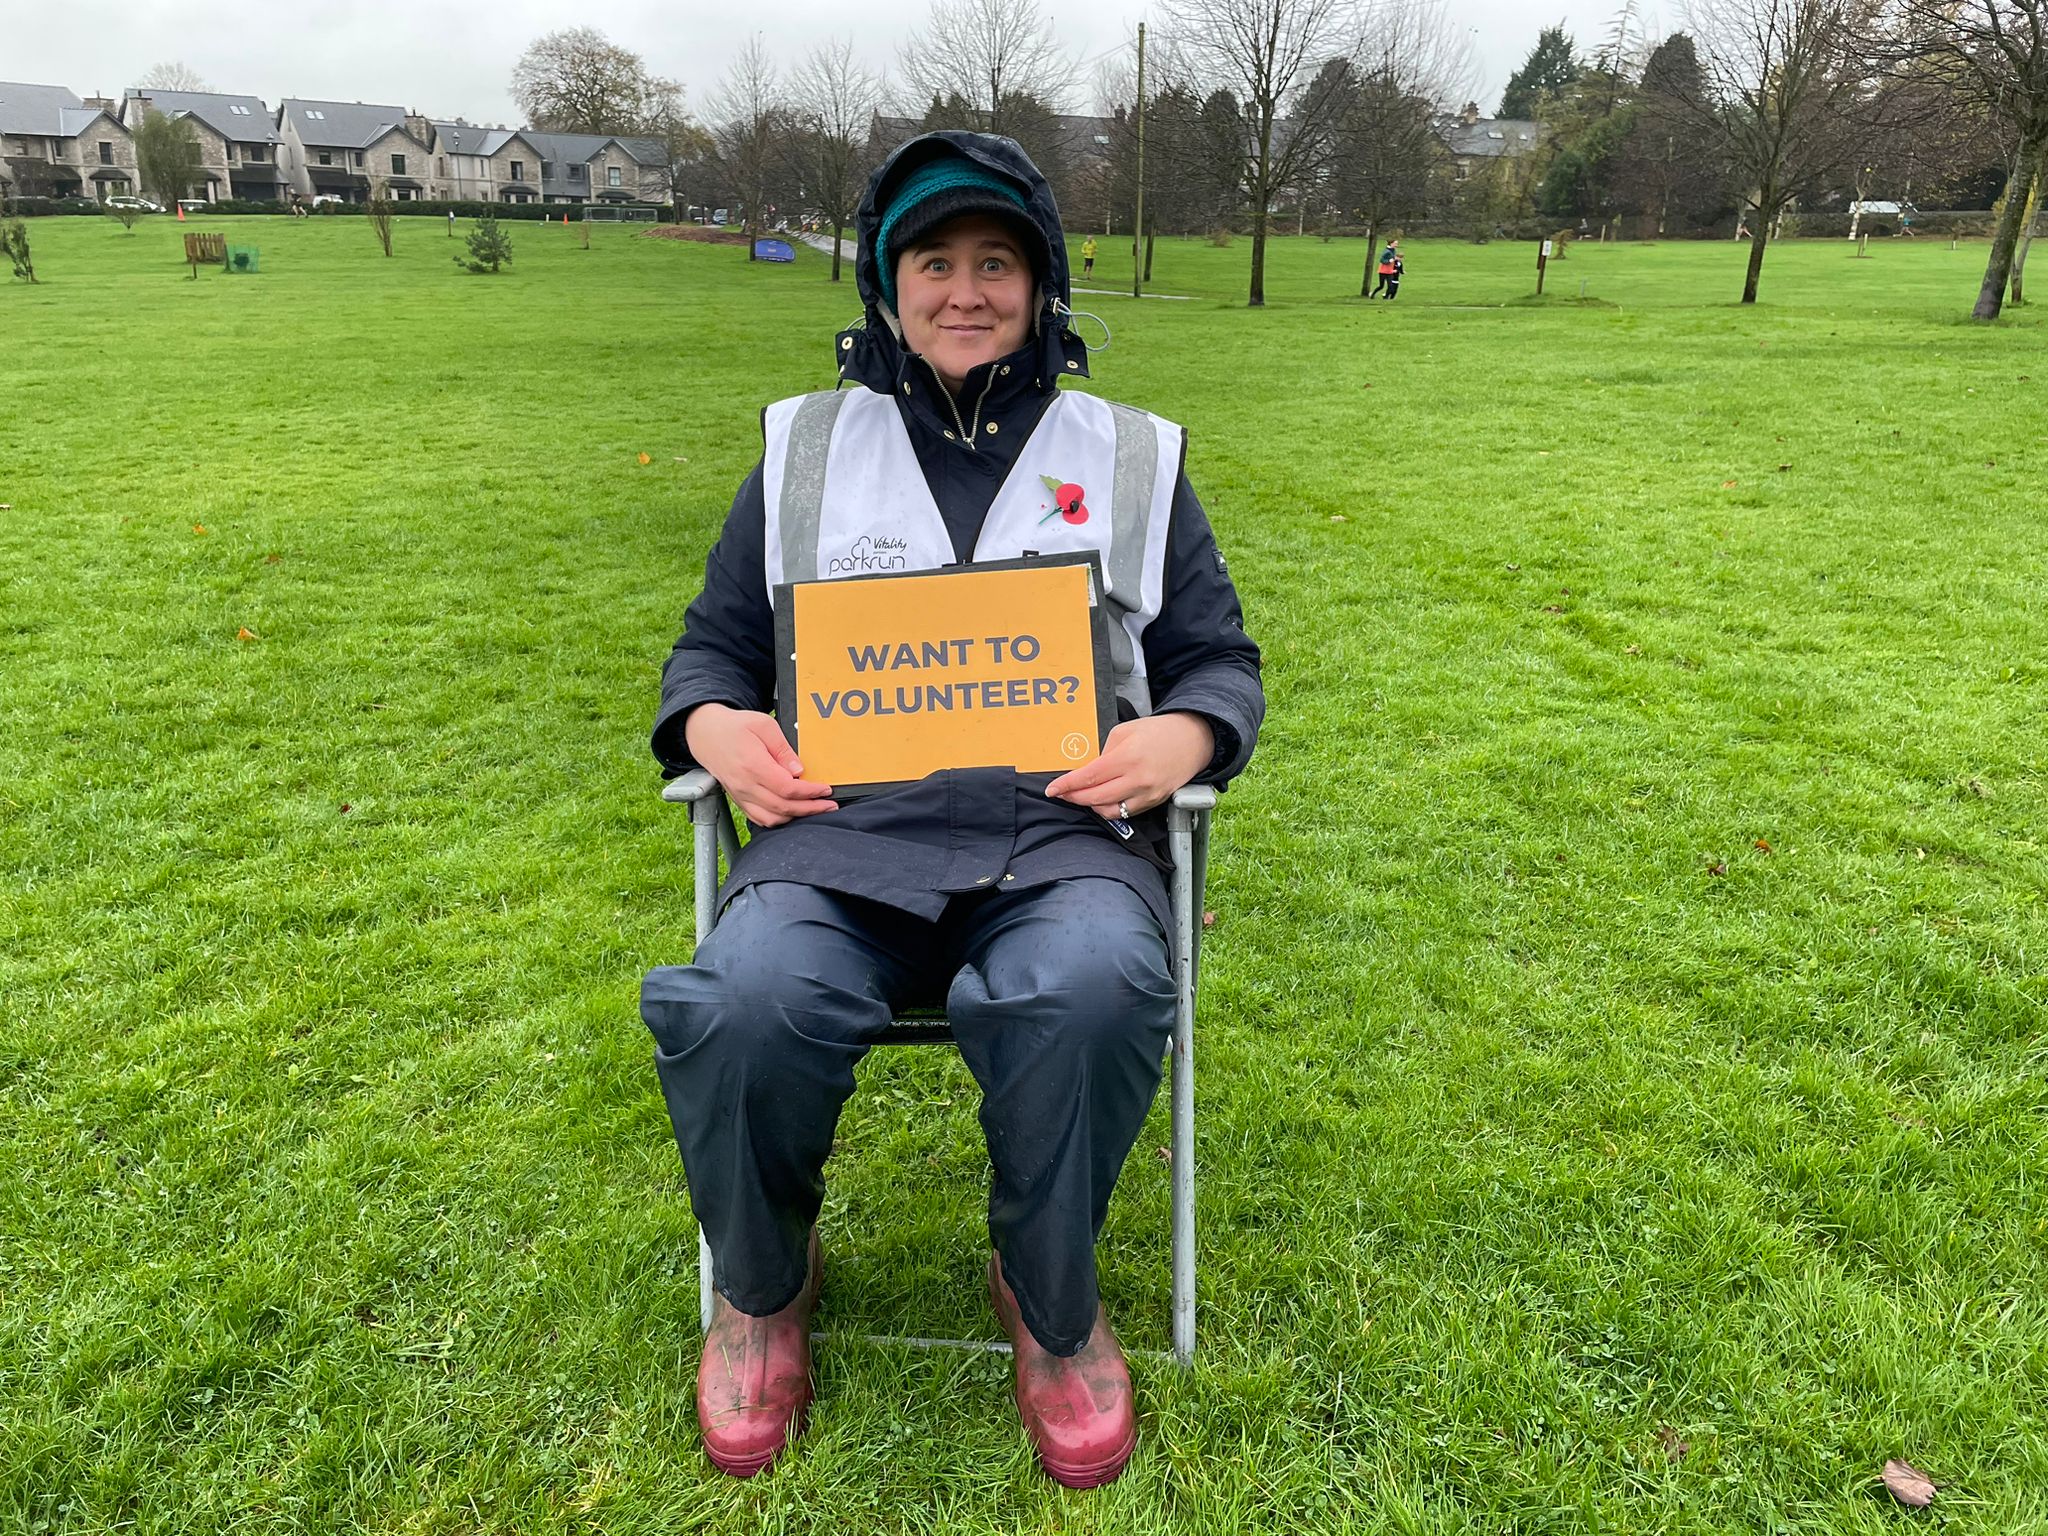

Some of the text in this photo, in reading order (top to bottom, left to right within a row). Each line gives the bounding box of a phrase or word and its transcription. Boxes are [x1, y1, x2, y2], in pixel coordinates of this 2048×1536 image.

[828, 547, 906, 576] parkrun
[873, 536, 907, 553] Vitality
[847, 634, 1041, 673] WANT TO
[810, 676, 1080, 719] VOLUNTEER?
